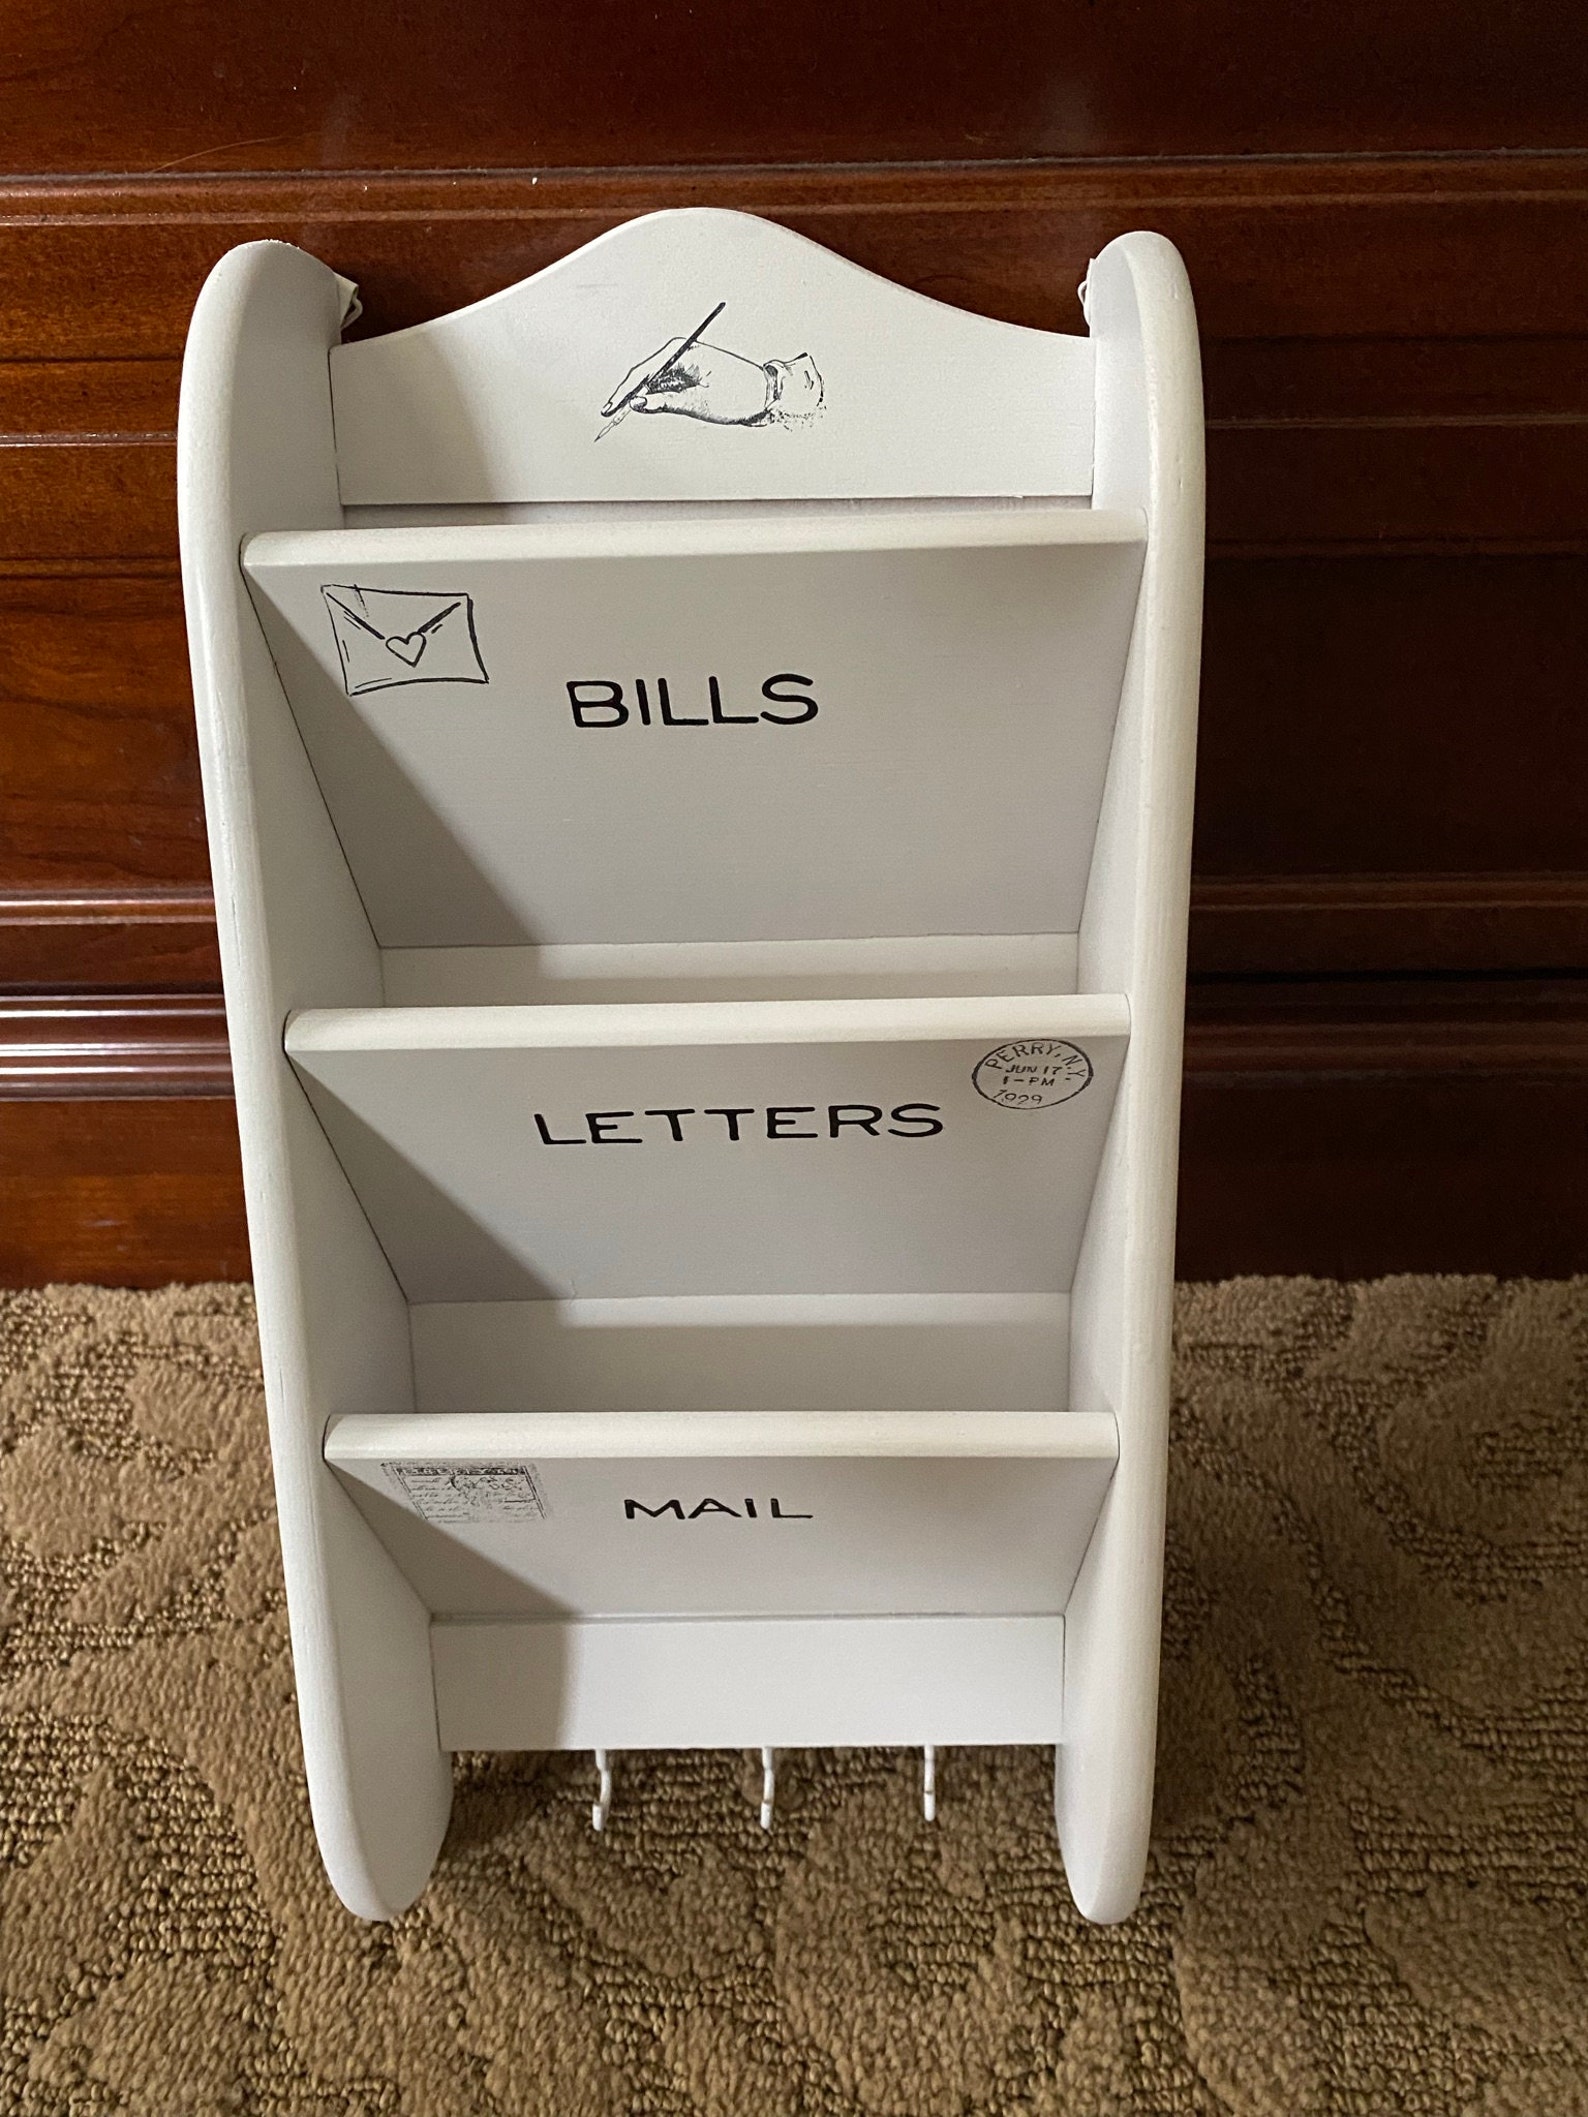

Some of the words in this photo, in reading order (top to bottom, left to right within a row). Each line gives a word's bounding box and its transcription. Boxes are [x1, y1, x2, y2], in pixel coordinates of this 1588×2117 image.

[566, 674, 818, 728] BILLS
[1005, 1064, 1038, 1074] JUN
[1043, 1066, 1063, 1075] 17
[534, 1103, 943, 1144] LETTERS
[624, 1498, 813, 1519] MAIL
